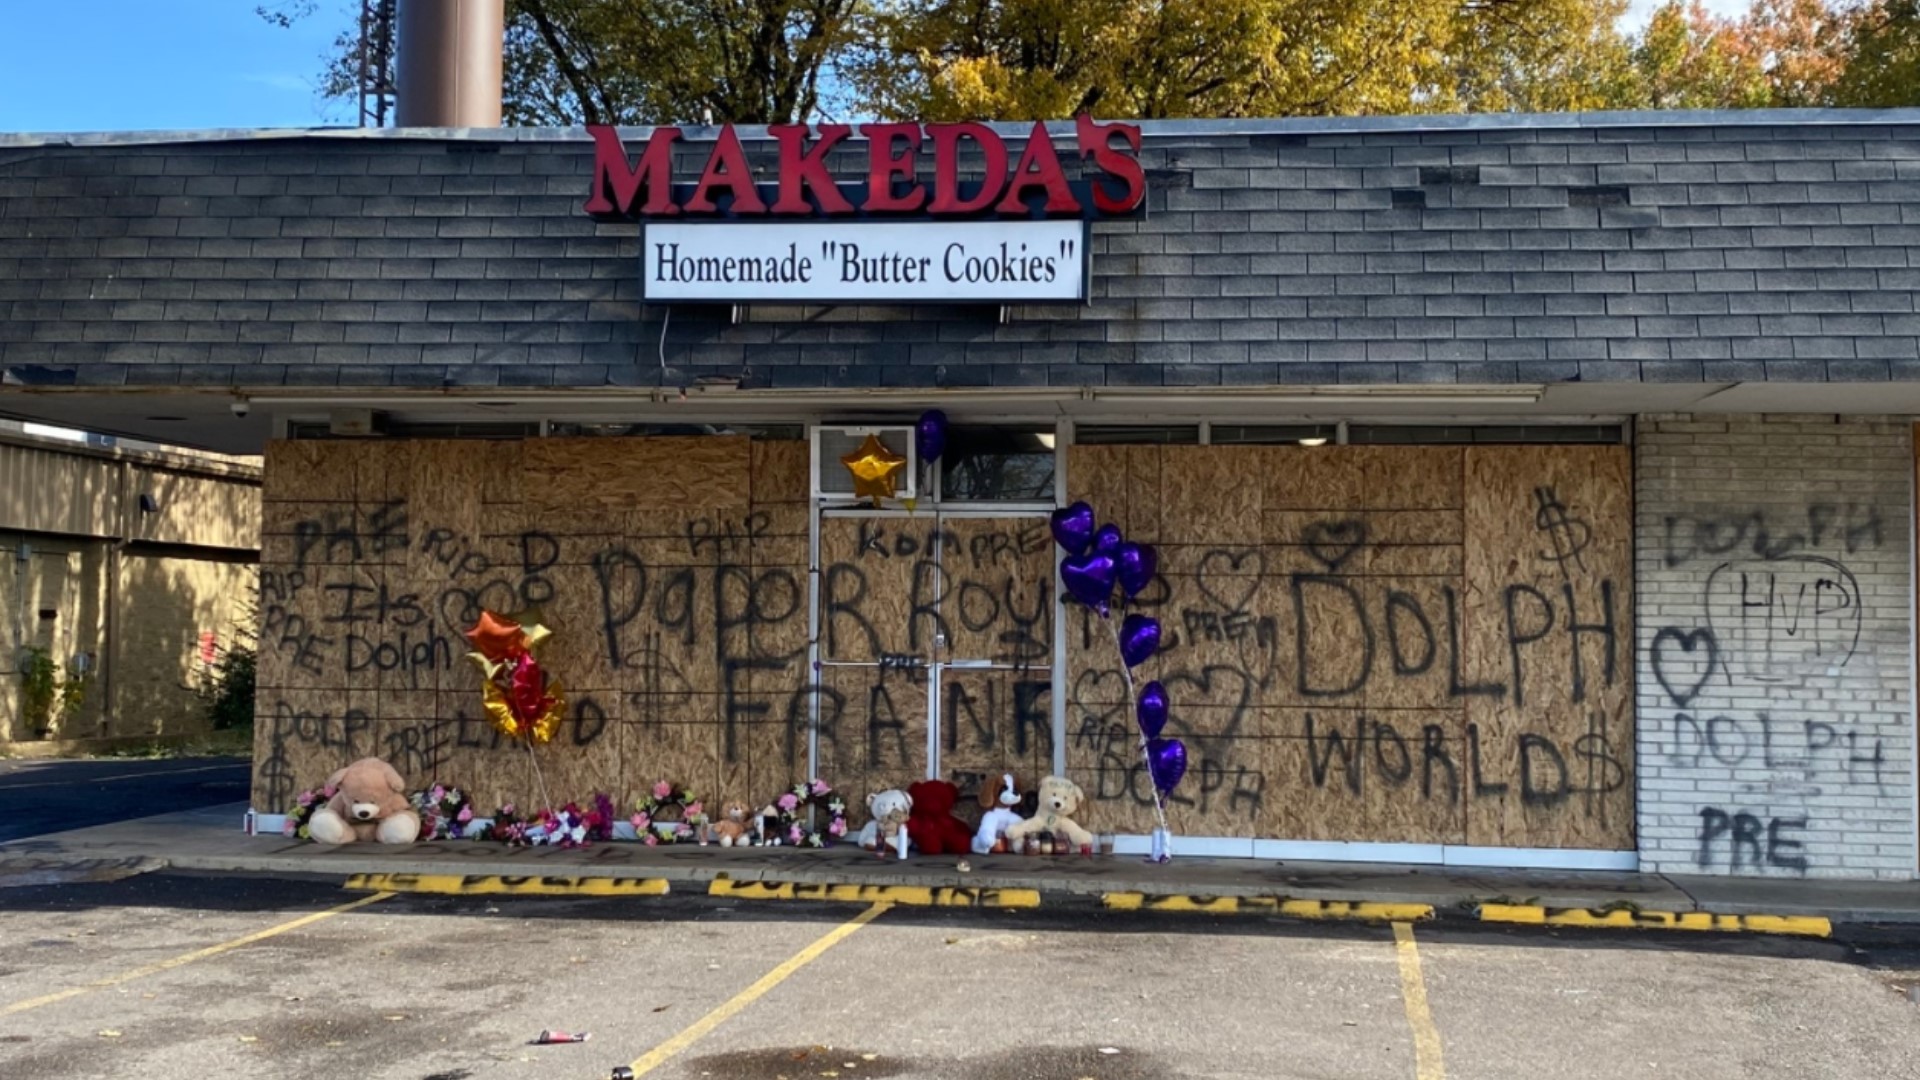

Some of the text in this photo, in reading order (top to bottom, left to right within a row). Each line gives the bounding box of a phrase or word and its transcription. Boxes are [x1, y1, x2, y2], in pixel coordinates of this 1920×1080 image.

[584, 113, 1146, 214] MAKEDA'S
[654, 239, 1075, 283] Homemade "Butter Cookies"
[345, 621, 450, 692] Dolph
[1292, 573, 1618, 706] DOLPH
[1699, 805, 1807, 873] PRE
